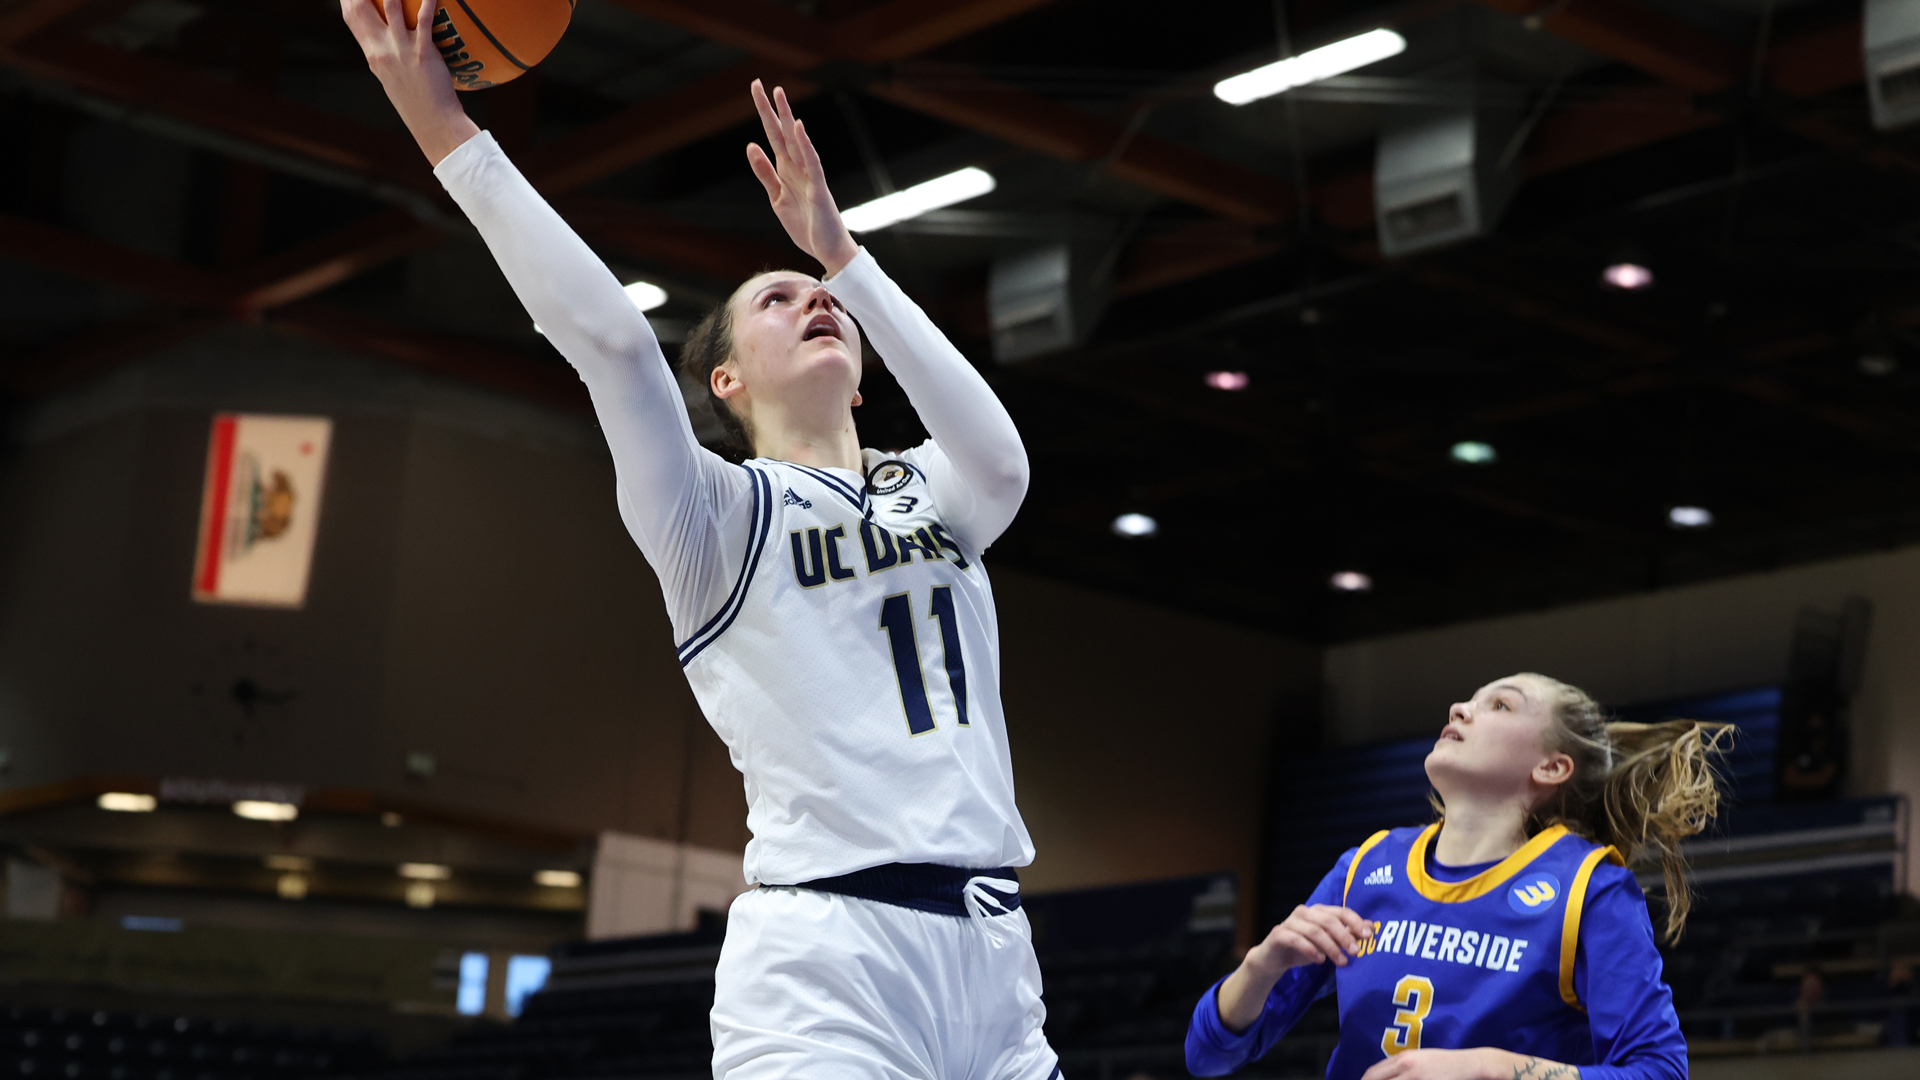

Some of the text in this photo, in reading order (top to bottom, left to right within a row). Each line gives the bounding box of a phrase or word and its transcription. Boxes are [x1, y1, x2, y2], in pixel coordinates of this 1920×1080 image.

[431, 7, 499, 89] Wilso
[876, 486, 896, 495] United
[789, 517, 972, 590] UC DAIS
[878, 583, 971, 738] 11
[1380, 973, 1435, 1059] 3
